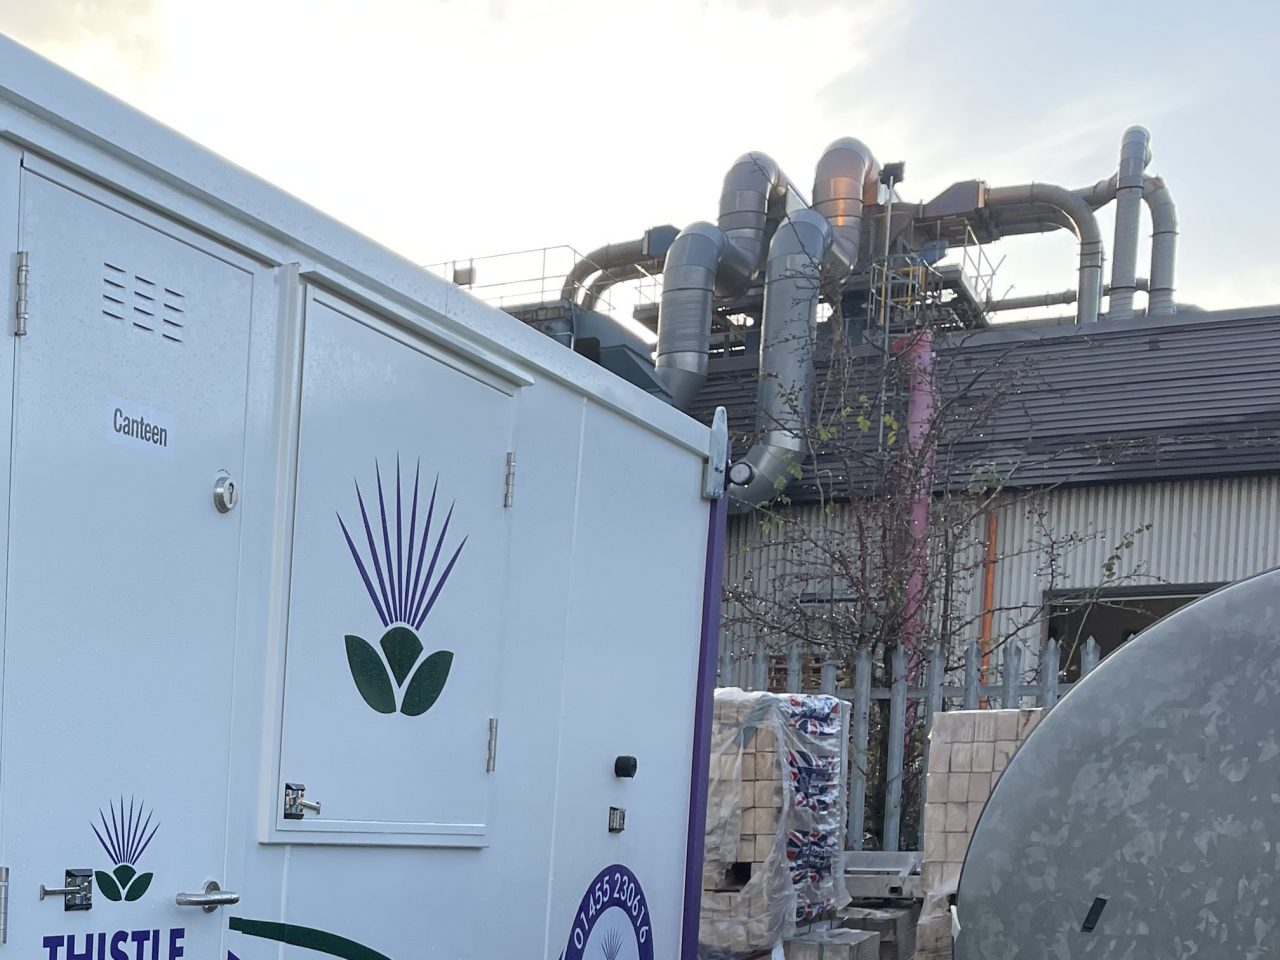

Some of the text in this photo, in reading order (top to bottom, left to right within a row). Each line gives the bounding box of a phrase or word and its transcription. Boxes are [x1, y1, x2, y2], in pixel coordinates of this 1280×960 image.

[113, 407, 168, 447] Canteen
[573, 872, 649, 950] 01455 230616
